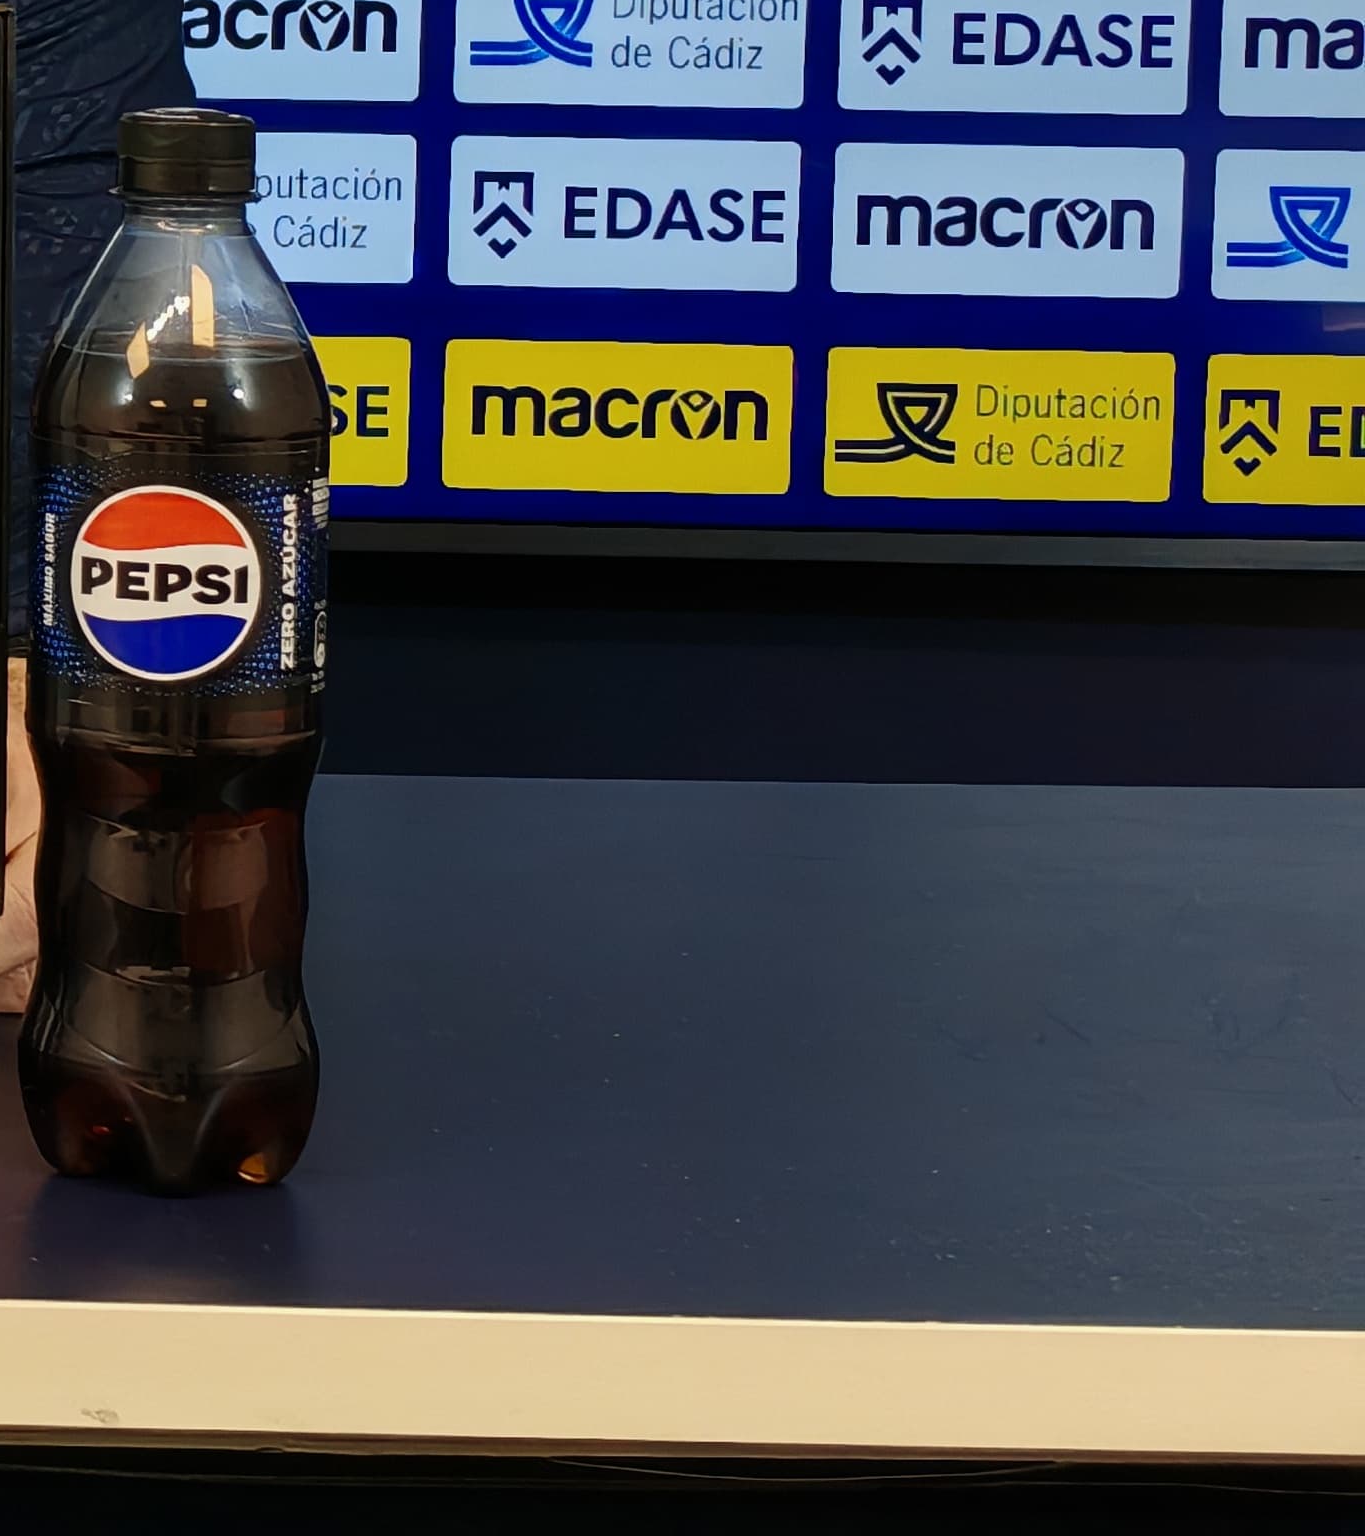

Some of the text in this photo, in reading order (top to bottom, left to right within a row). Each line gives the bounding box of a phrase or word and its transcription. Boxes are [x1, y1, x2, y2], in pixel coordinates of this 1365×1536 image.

[610, 35, 763, 70] de Cádiz
[952, 12, 1175, 69] EDASE
[254, 165, 402, 205] putación
[273, 214, 368, 249] Cádiz
[563, 186, 786, 244] EDASE
[856, 194, 1155, 251] macron
[471, 385, 769, 441] macron
[976, 383, 1161, 424] Diputación
[973, 433, 1125, 468] de Cádiz
[43, 512, 56, 564] SABOR
[80, 556, 249, 605] PEPSI
[280, 493, 299, 671] ZERO AZÚCAR
